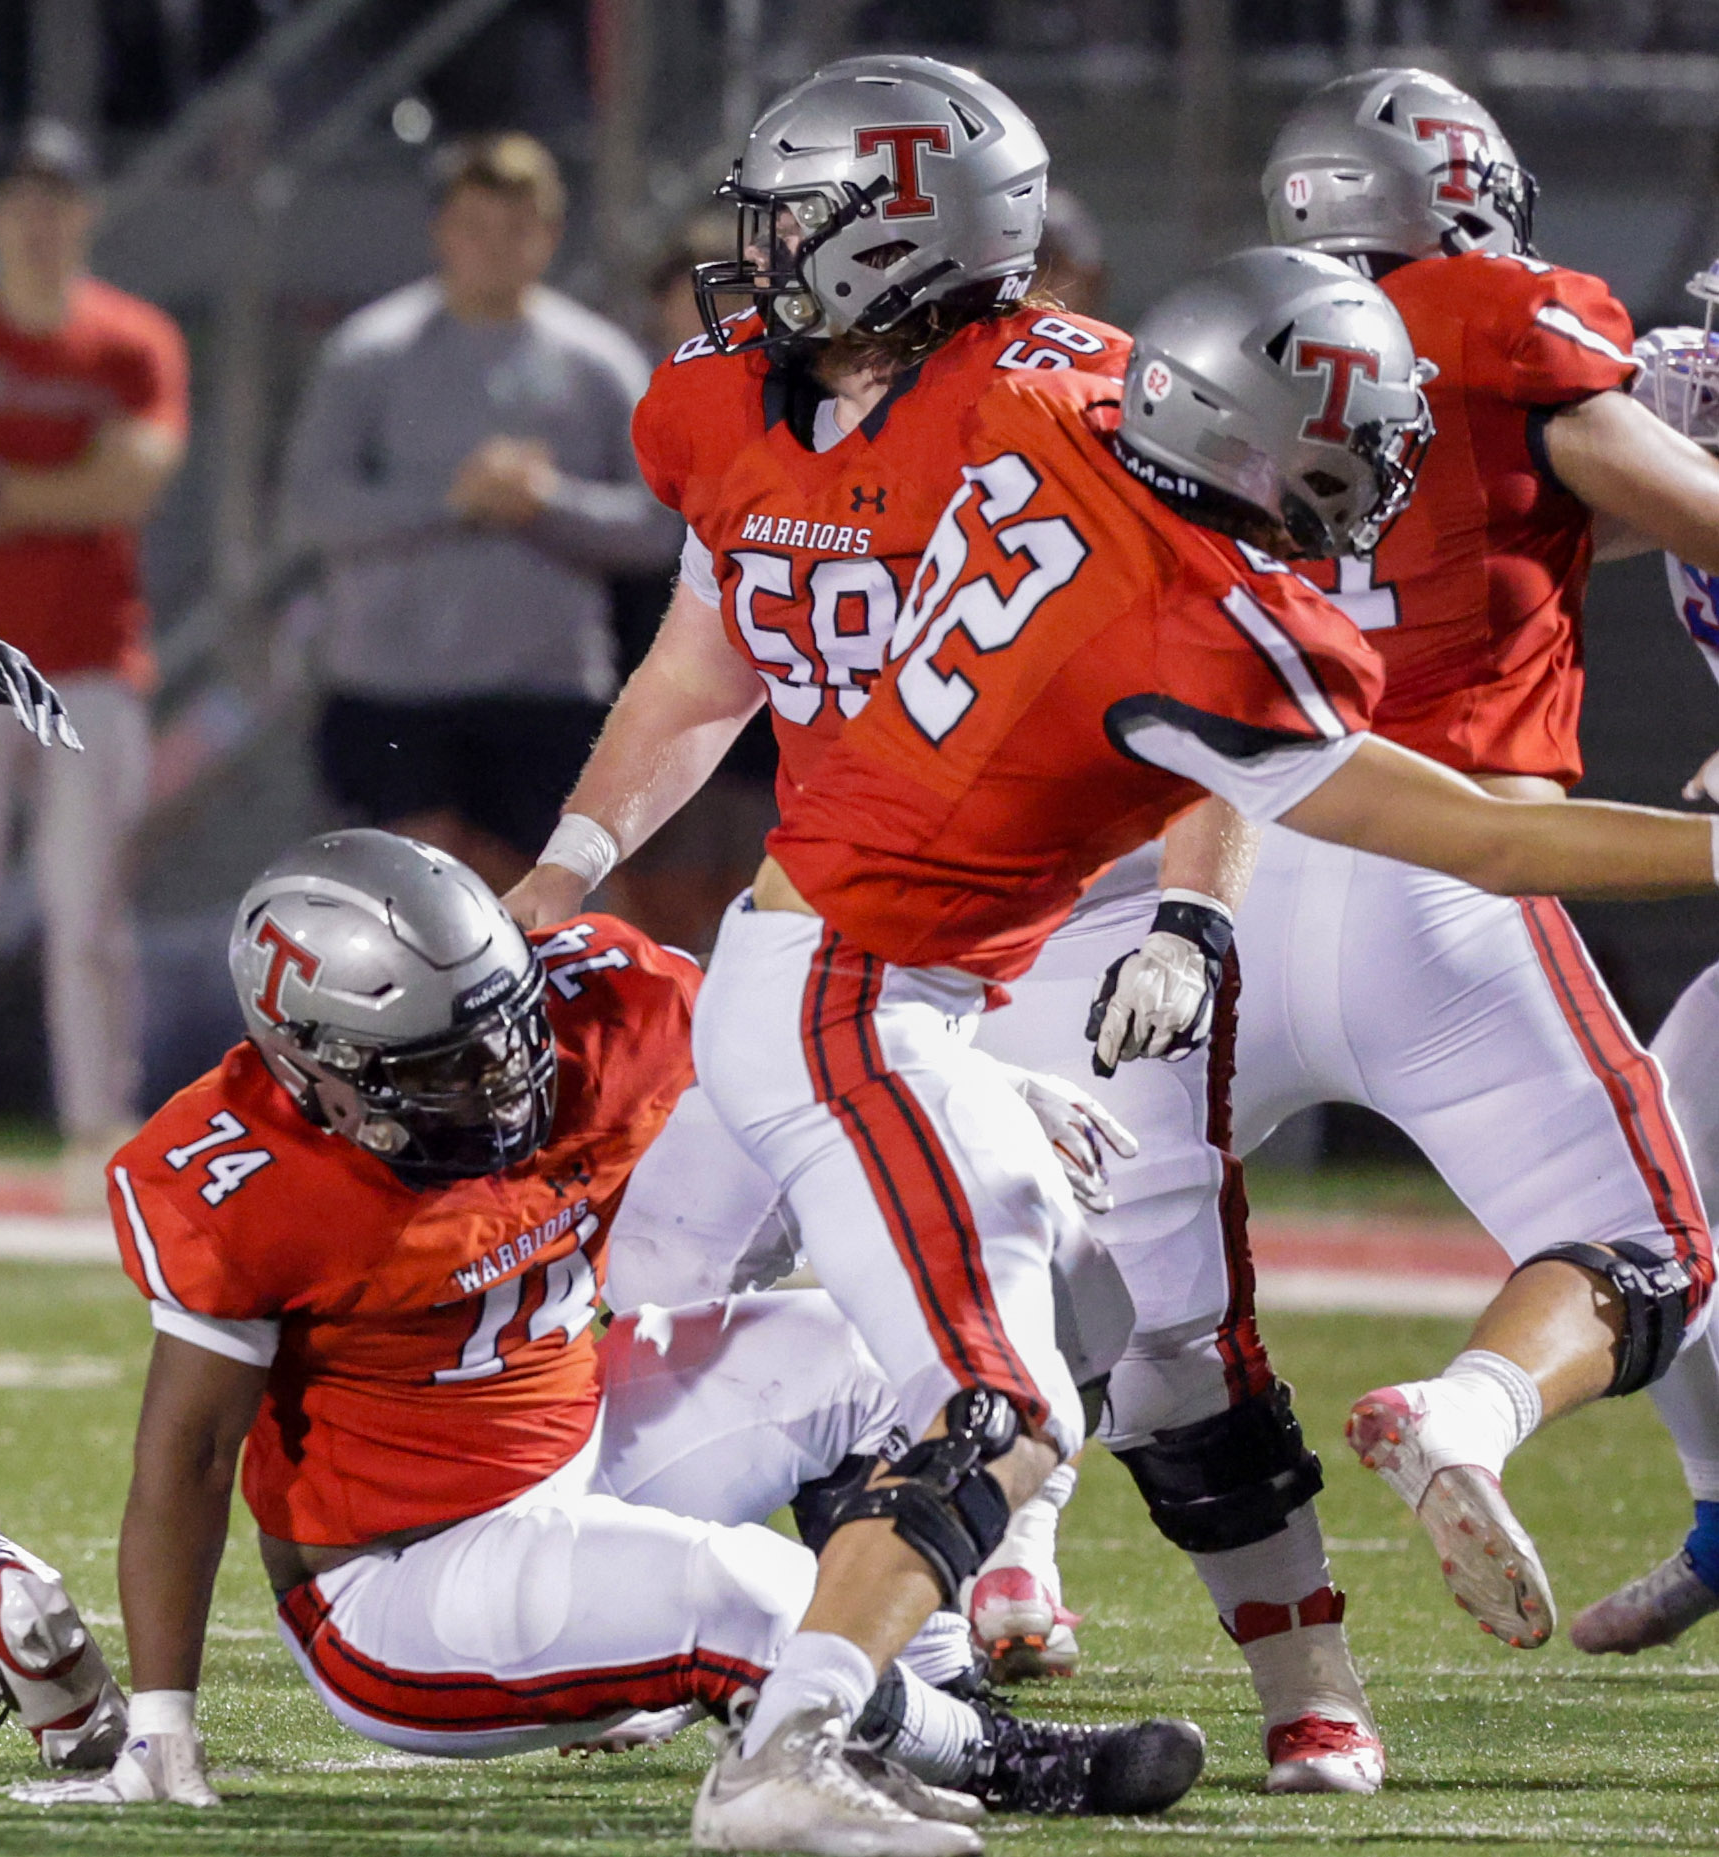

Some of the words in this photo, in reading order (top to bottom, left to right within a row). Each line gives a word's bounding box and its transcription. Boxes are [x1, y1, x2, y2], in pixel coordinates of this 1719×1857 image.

[851, 121, 955, 224] T
[1289, 178, 1307, 202] 71
[1408, 113, 1490, 209] T
[994, 316, 1105, 370] 58
[1146, 367, 1170, 397] 62
[1291, 336, 1381, 445] T
[740, 513, 873, 555] WARRIORS
[726, 549, 903, 727] 58
[888, 452, 1092, 750] 62
[248, 913, 325, 1034] T
[531, 922, 633, 1001] 74
[164, 1109, 277, 1208] 74
[452, 1197, 590, 1295] WARRIORS
[432, 1212, 601, 1385] 74
